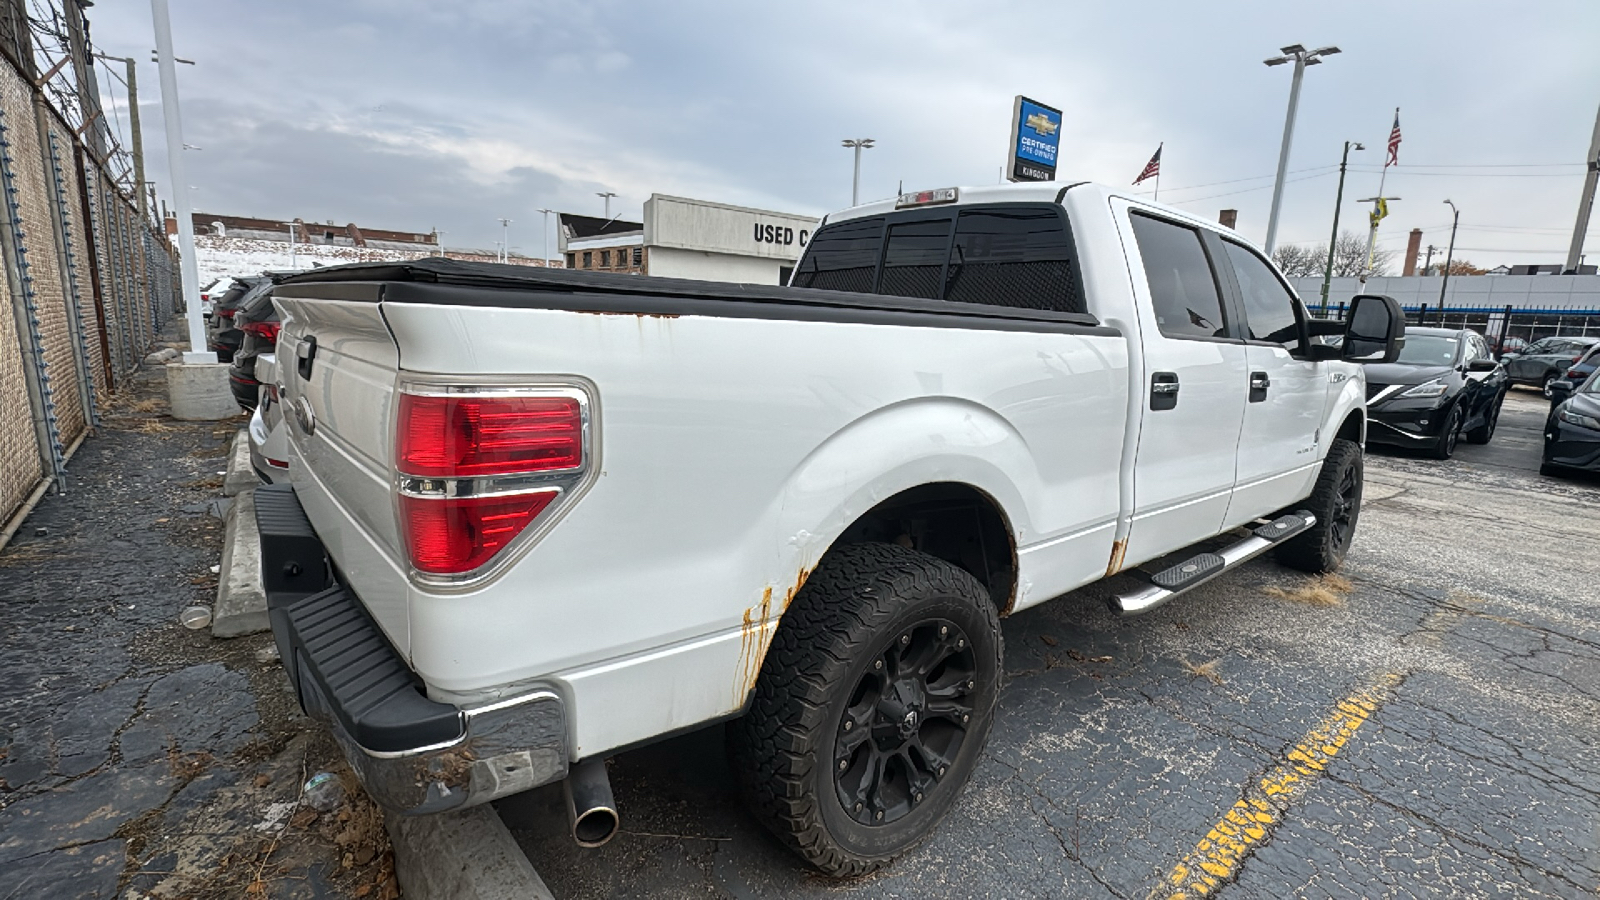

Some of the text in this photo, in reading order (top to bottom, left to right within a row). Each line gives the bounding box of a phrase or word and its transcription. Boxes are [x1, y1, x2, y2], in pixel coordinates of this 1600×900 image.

[1021, 136, 1056, 153] CERTIFIED
[1022, 145, 1054, 161] PRE-OWNED
[754, 223, 812, 247] USED C
